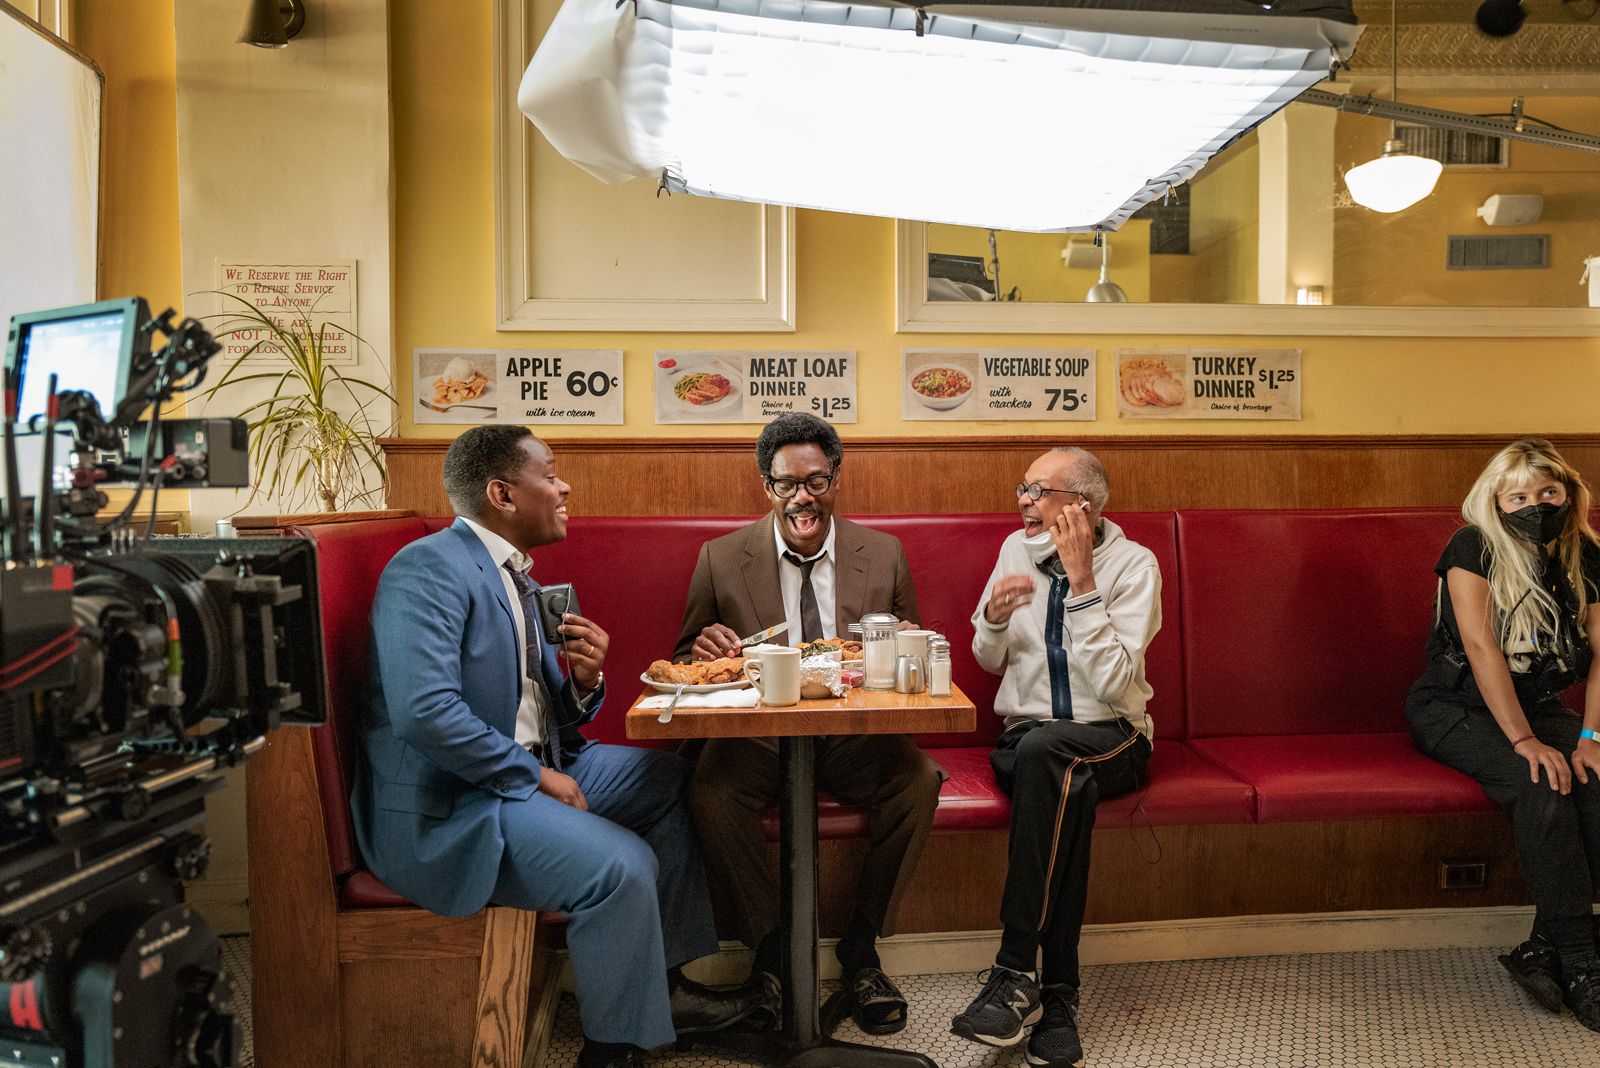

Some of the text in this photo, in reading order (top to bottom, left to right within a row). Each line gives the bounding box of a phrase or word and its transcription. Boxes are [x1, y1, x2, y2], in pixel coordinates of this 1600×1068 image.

[231, 329, 262, 341] NOT
[506, 357, 562, 377] APPLE
[750, 358, 847, 378] MEAT LOAF
[983, 357, 1089, 377] VEGETABLE SOUP
[1192, 356, 1257, 376] TURKEY
[520, 381, 548, 401] PIE
[750, 381, 807, 396] DINNER
[989, 386, 1012, 398] with
[1193, 379, 1256, 398] DINNER
[761, 400, 793, 410] Choice of
[989, 398, 1032, 409] crackers
[1210, 403, 1273, 413] Choice of beverage
[525, 407, 596, 418] with ice cream
